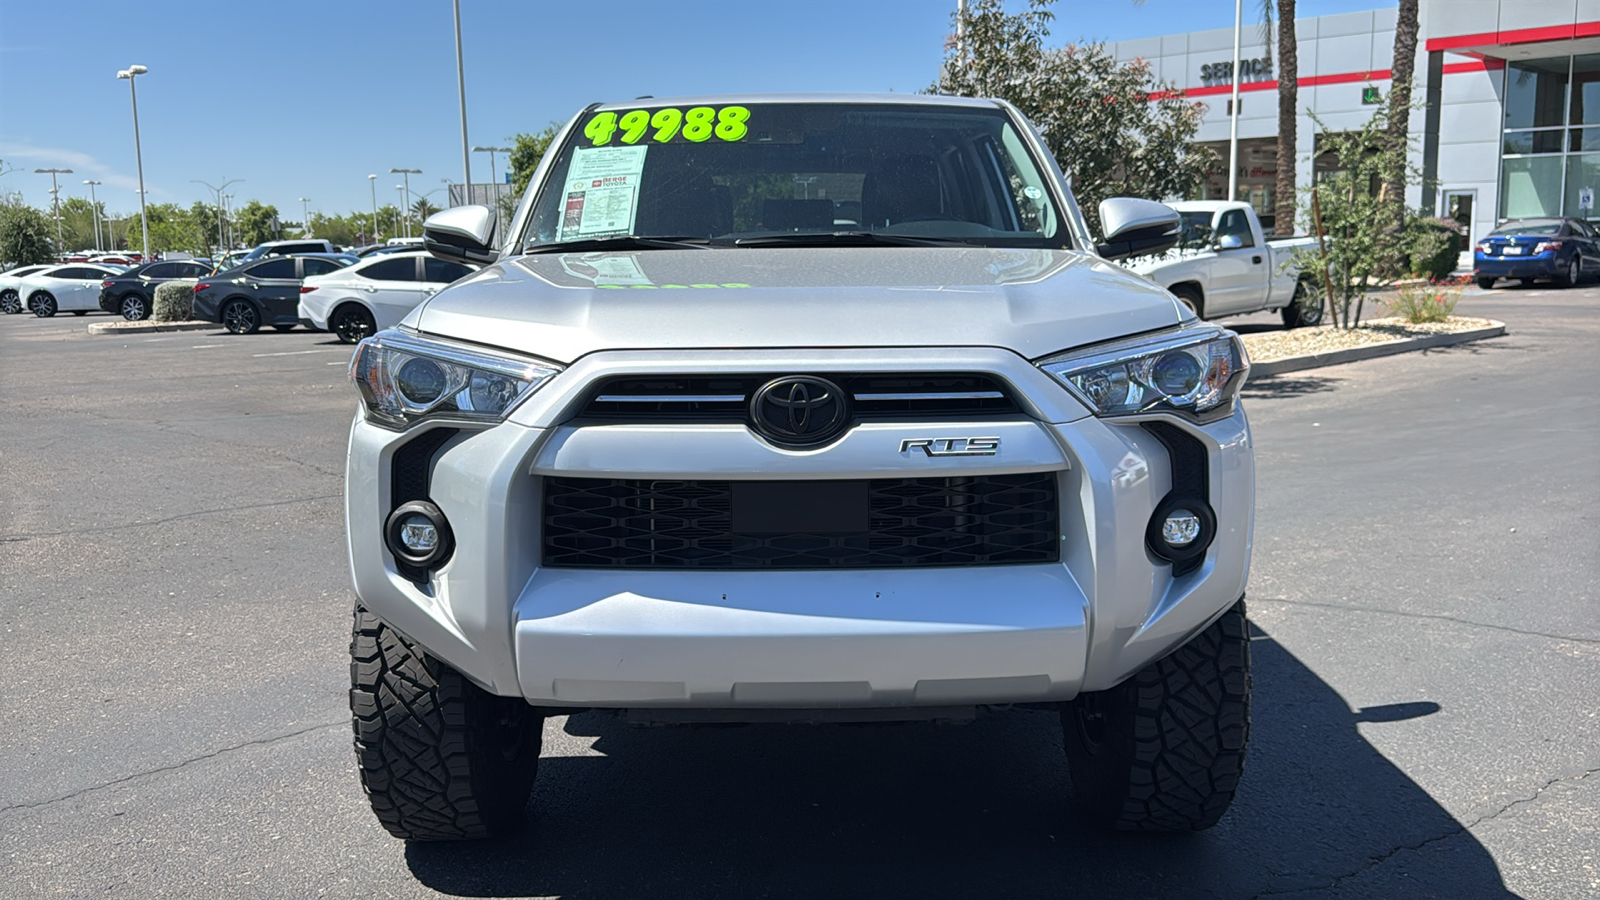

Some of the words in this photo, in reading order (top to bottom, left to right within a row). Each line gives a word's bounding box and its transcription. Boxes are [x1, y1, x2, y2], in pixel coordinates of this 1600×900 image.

[1200, 57, 1273, 81] SERVICE
[584, 106, 750, 146] 49988
[899, 436, 1000, 457] RTS
